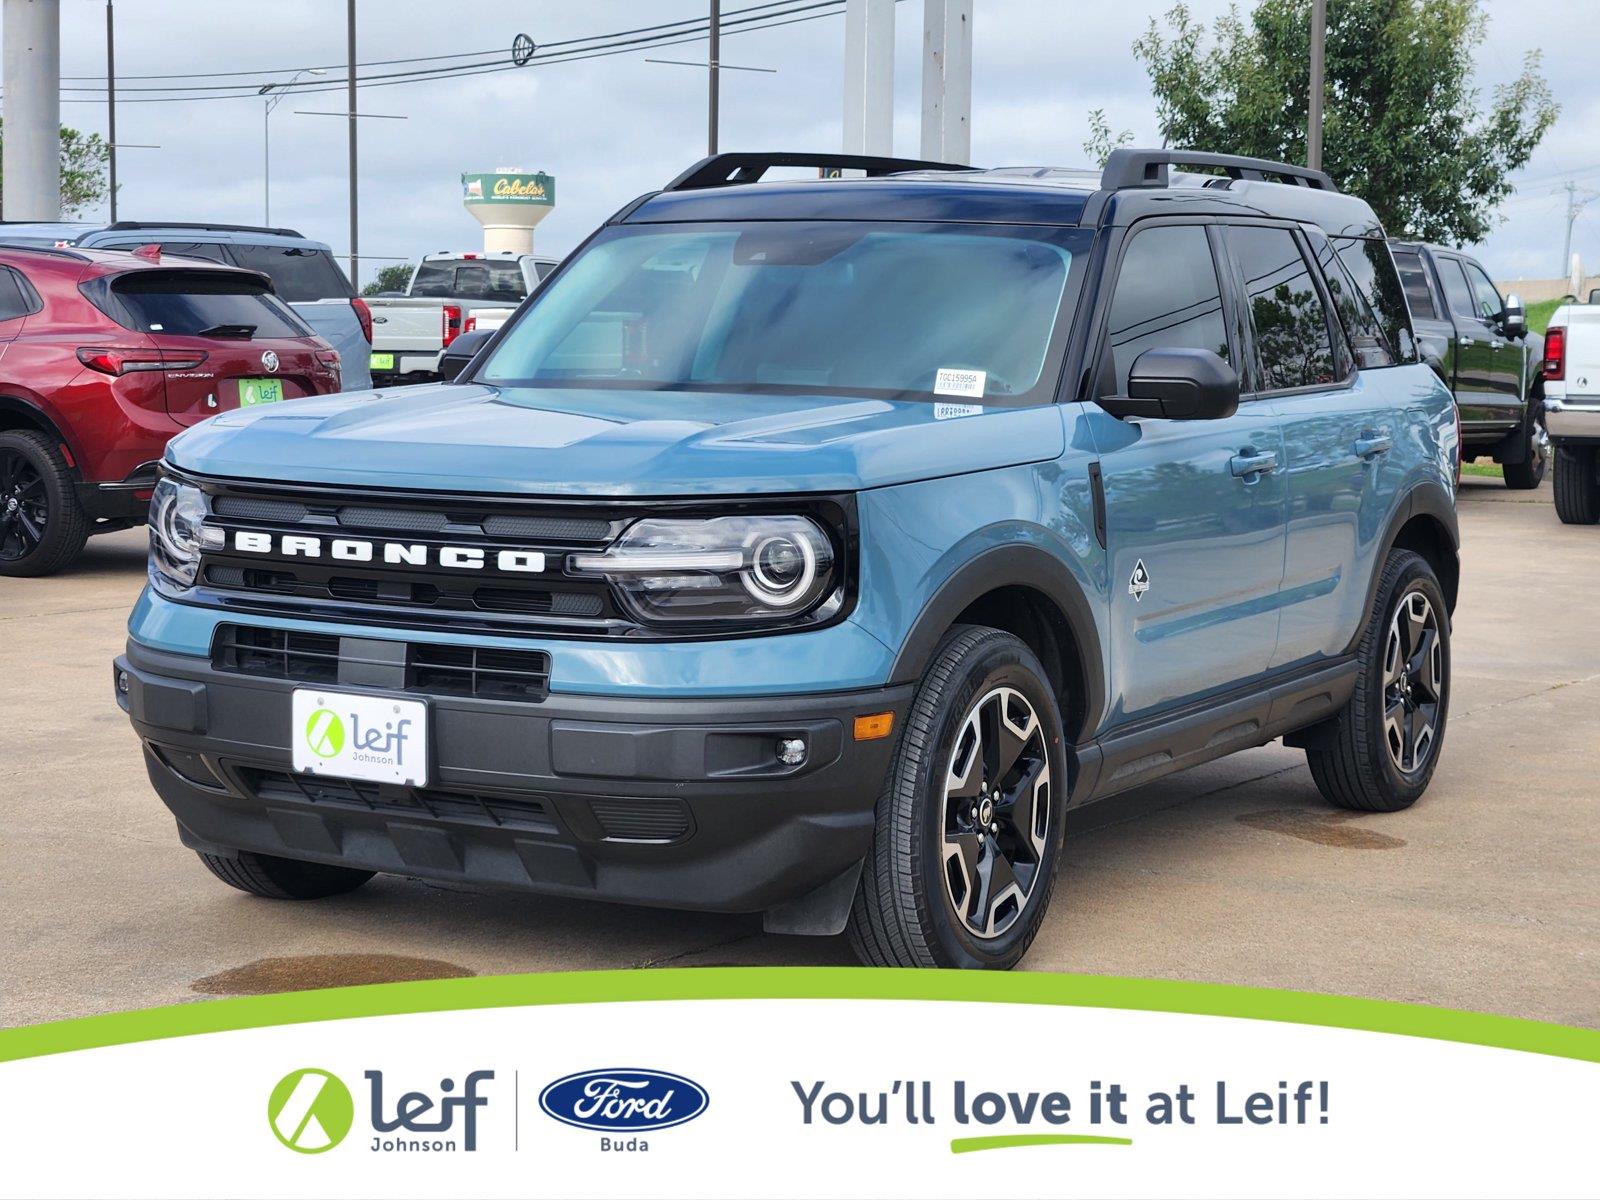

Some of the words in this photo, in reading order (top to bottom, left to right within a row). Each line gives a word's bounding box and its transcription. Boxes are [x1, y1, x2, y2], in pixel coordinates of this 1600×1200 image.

[258, 385, 277, 402] leif
[235, 532, 545, 573] BRONCO
[351, 713, 411, 765] leif
[352, 752, 394, 765] Johnson
